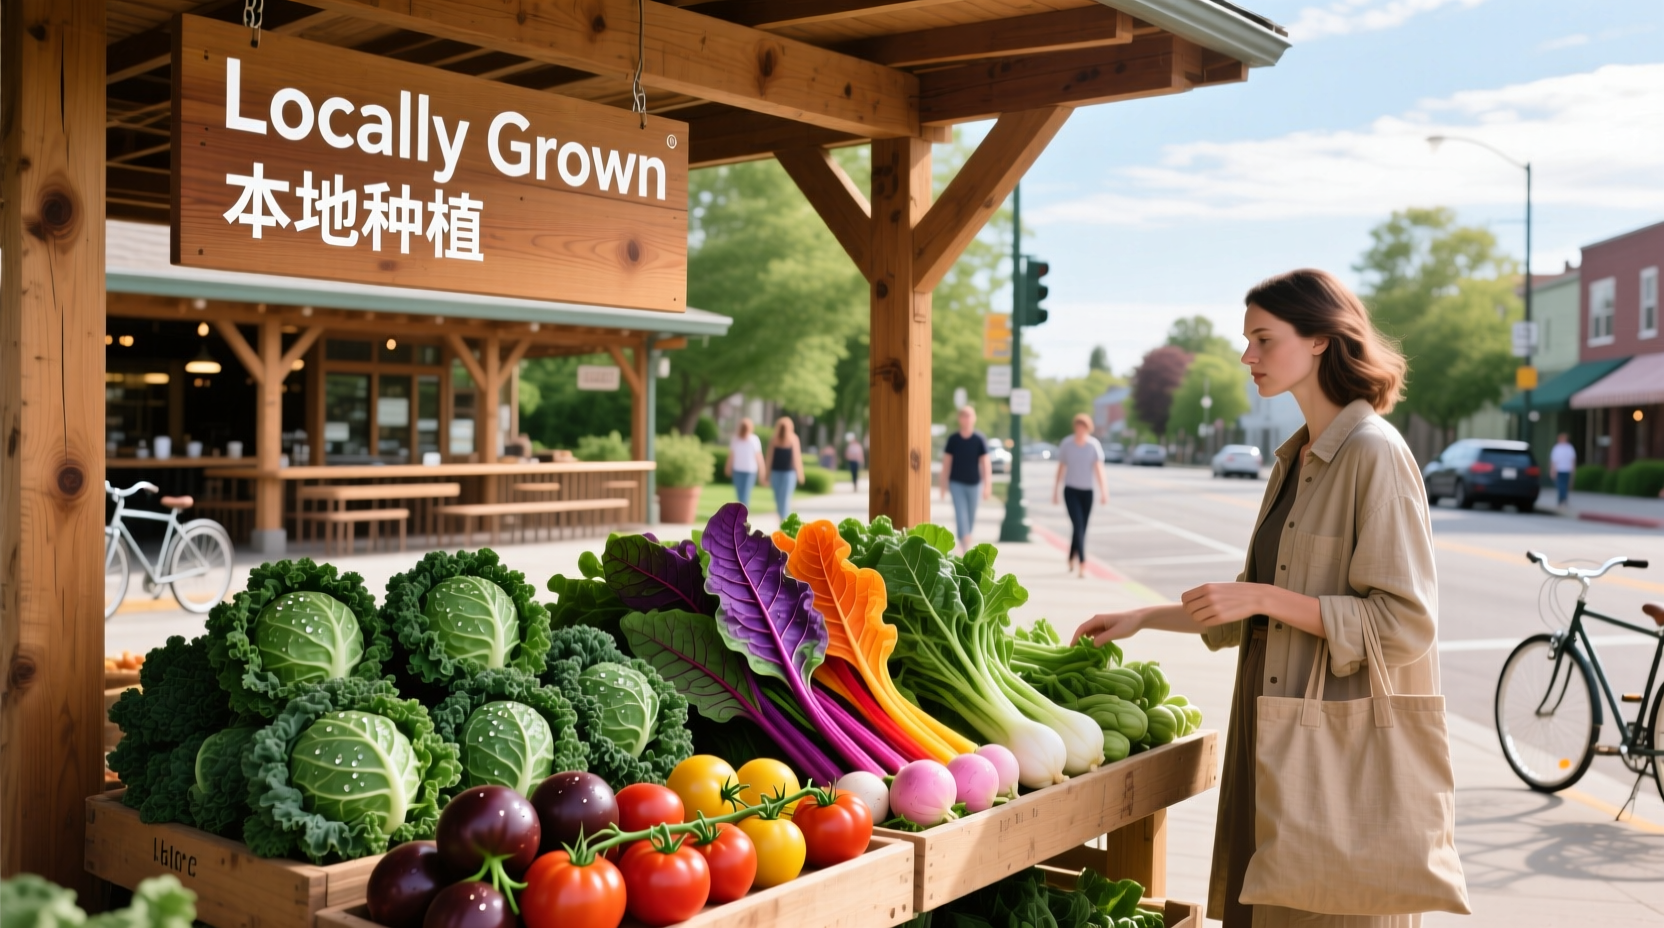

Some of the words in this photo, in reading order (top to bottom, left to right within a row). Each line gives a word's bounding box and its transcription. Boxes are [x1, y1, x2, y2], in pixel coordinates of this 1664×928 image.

[225, 57, 470, 184] Locally
[487, 111, 666, 201] Grown
[222, 162, 485, 262] 本地种植
